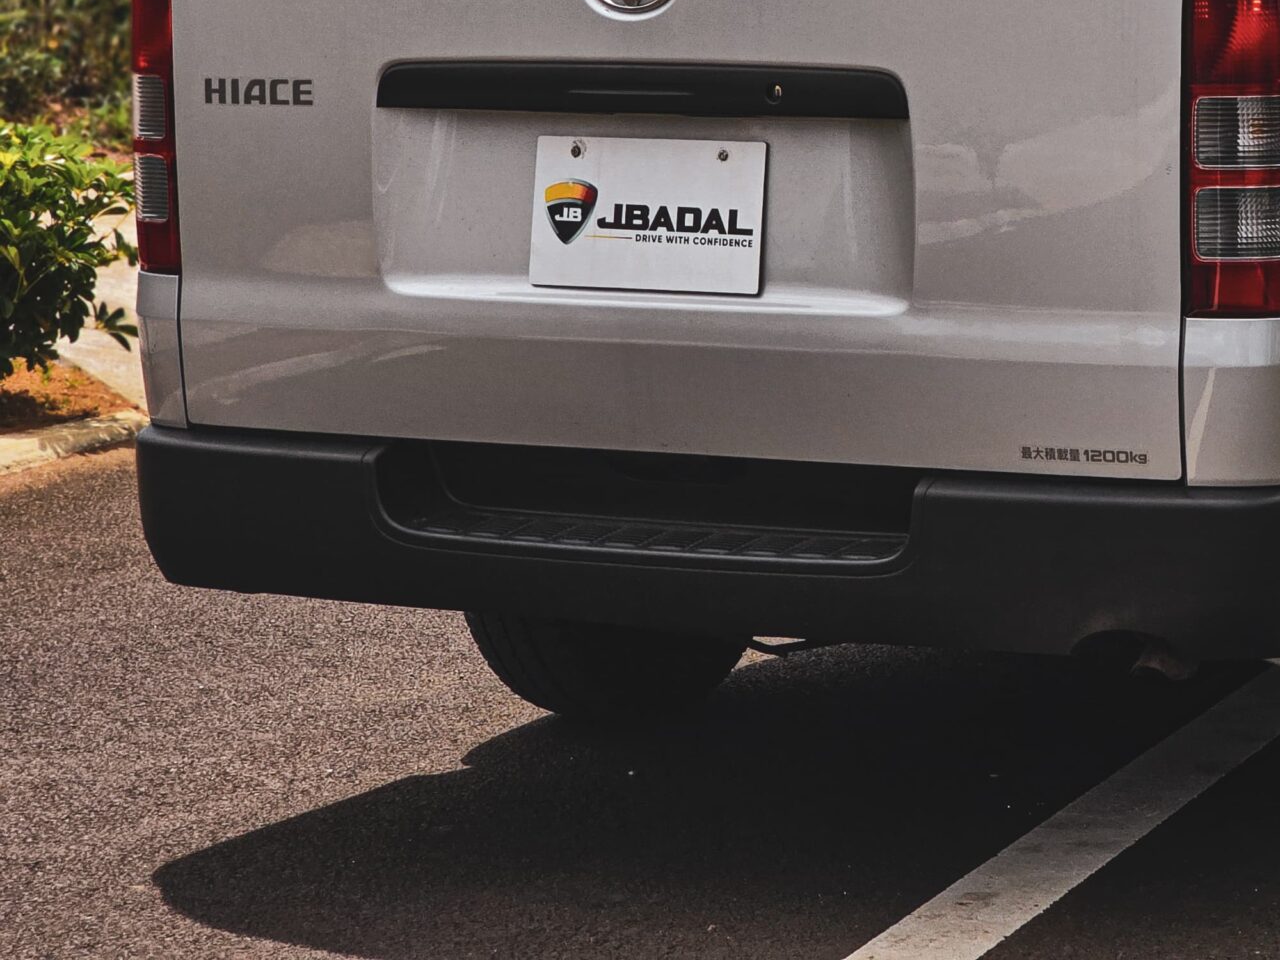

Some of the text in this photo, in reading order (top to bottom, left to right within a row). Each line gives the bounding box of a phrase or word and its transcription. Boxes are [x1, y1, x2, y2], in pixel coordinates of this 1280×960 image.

[205, 78, 314, 105] HIACE
[554, 207, 582, 222] JB
[597, 203, 753, 236] JBADAL
[635, 233, 753, 248] DRIVE WITH CONFIDENCE
[1083, 449, 1148, 464] 1200kg
